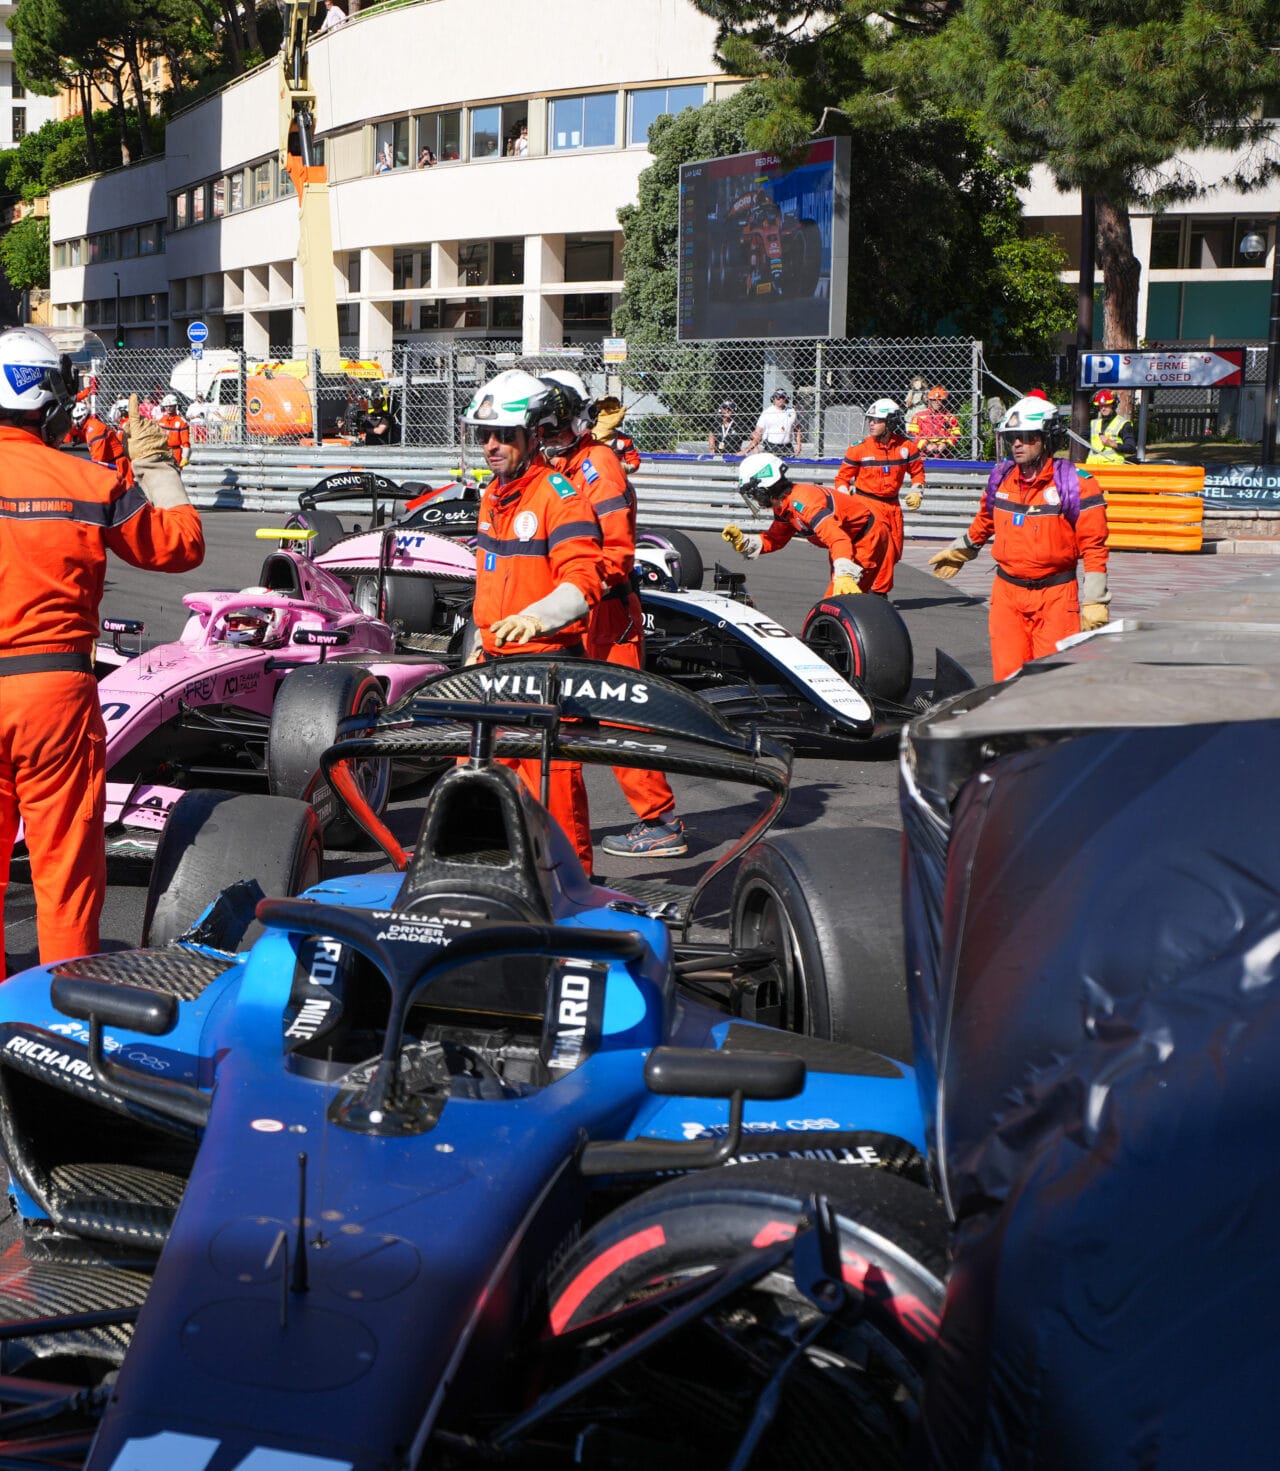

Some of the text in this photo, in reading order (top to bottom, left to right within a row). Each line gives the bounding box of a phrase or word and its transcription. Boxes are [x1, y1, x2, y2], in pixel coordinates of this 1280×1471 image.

[1091, 356, 1113, 382] P
[13, 367, 42, 387] ACM
[1145, 373, 1191, 382] CLOSED
[1205, 475, 1263, 487] STATION
[1203, 487, 1232, 497] TEL.
[18, 501, 30, 513] DE
[31, 500, 73, 513] MONACO
[736, 622, 794, 639] 16
[317, 635, 338, 644] BWT
[478, 674, 649, 705] WILIAMS
[372, 912, 472, 928] WILLIAMS
[389, 925, 444, 937] DRIVER
[376, 931, 453, 947] ACADEMY
